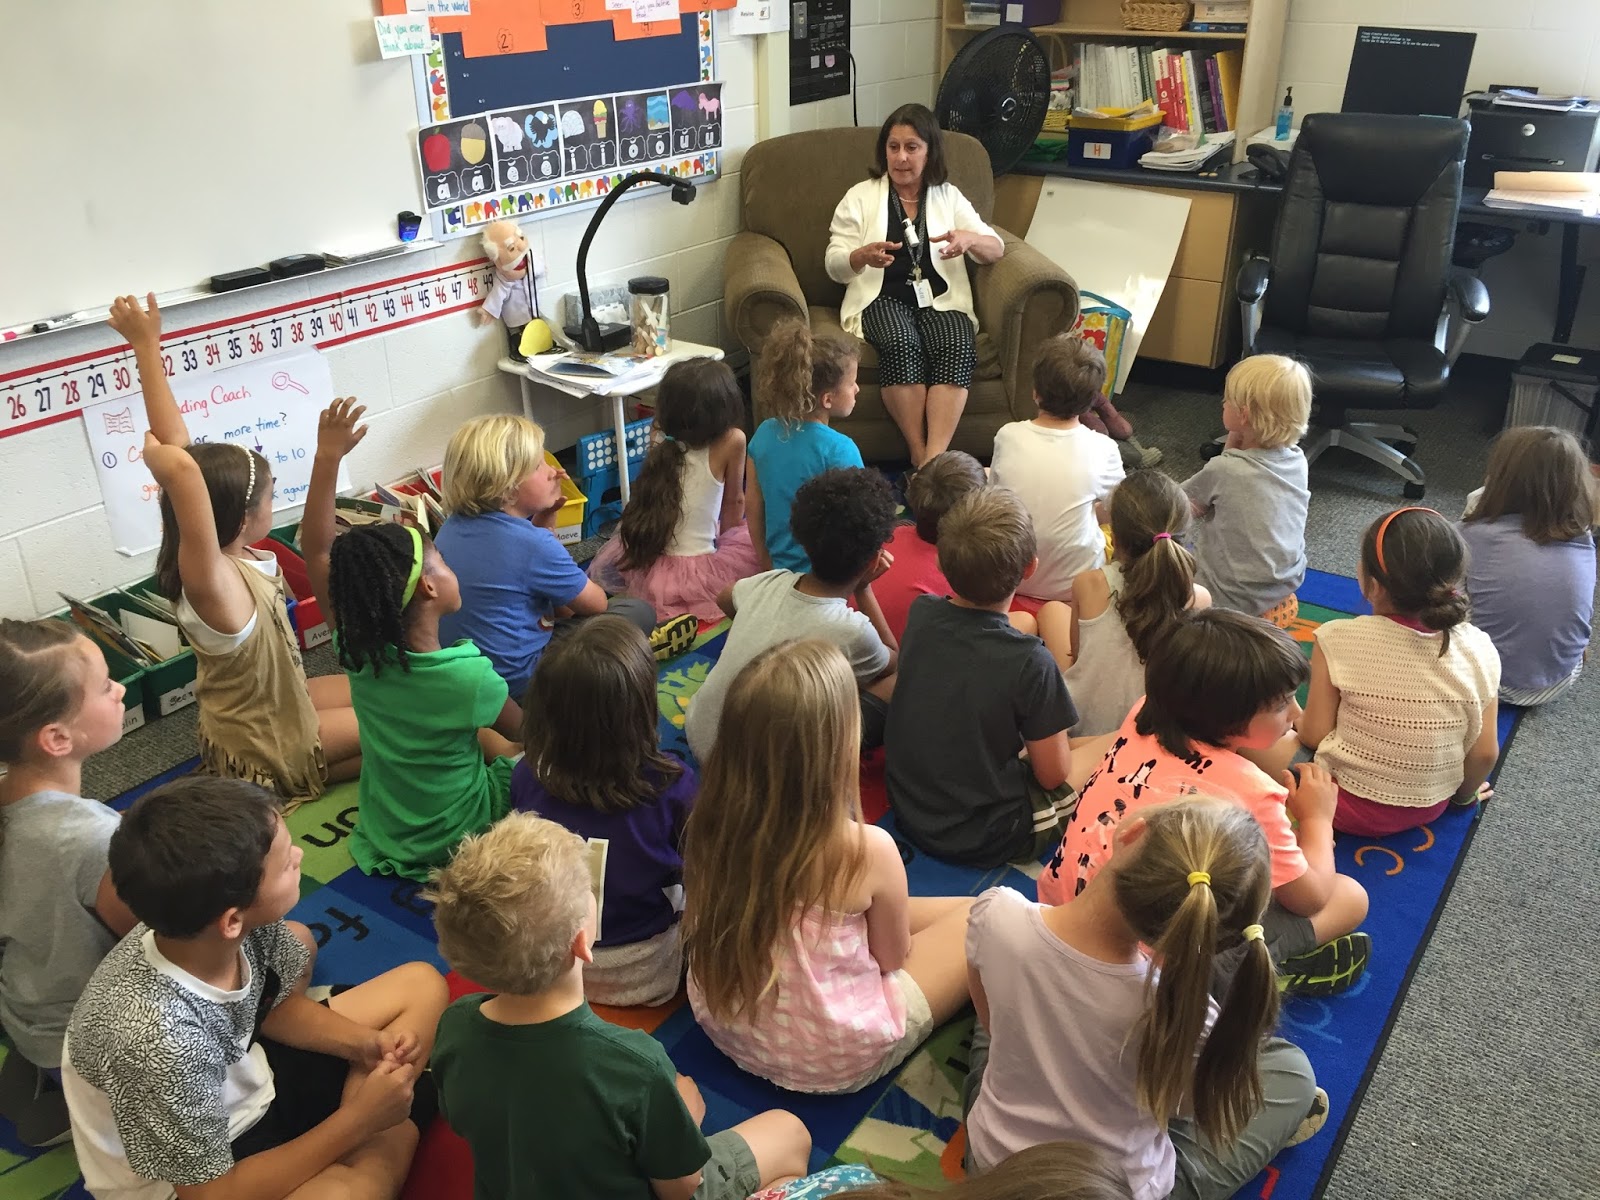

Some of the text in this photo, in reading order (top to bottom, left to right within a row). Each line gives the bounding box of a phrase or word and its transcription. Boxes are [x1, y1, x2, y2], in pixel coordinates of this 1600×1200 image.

[574, 2, 581, 16] 3
[377, 20, 425, 36] Did you ever
[500, 33, 509, 49] 2
[7, 394, 27, 420] 26
[34, 386, 51, 412] 27
[61, 379, 81, 405] 28
[87, 373, 107, 398] 29
[112, 366, 131, 391] 30
[181, 349, 198, 372] 33
[204, 342, 221, 366] 34
[227, 337, 243, 360] 35
[249, 332, 264, 354] 36
[270, 326, 283, 349] 37
[290, 322, 305, 343] 38
[310, 317, 325, 338] 39
[328, 312, 344, 333] 40
[347, 307, 359, 327] 41
[364, 303, 379, 323] 42
[383, 298, 396, 318] 43
[401, 294, 414, 313] 44
[418, 289, 431, 309] 45
[434, 285, 447, 304] 46
[452, 281, 462, 300] 47
[467, 277, 478, 296] 48
[482, 273, 494, 292] 49
[181, 385, 252, 418] ding Coach
[224, 425, 252, 440] more
[256, 411, 287, 432] time?
[275, 451, 288, 463] to
[291, 447, 306, 460] 10
